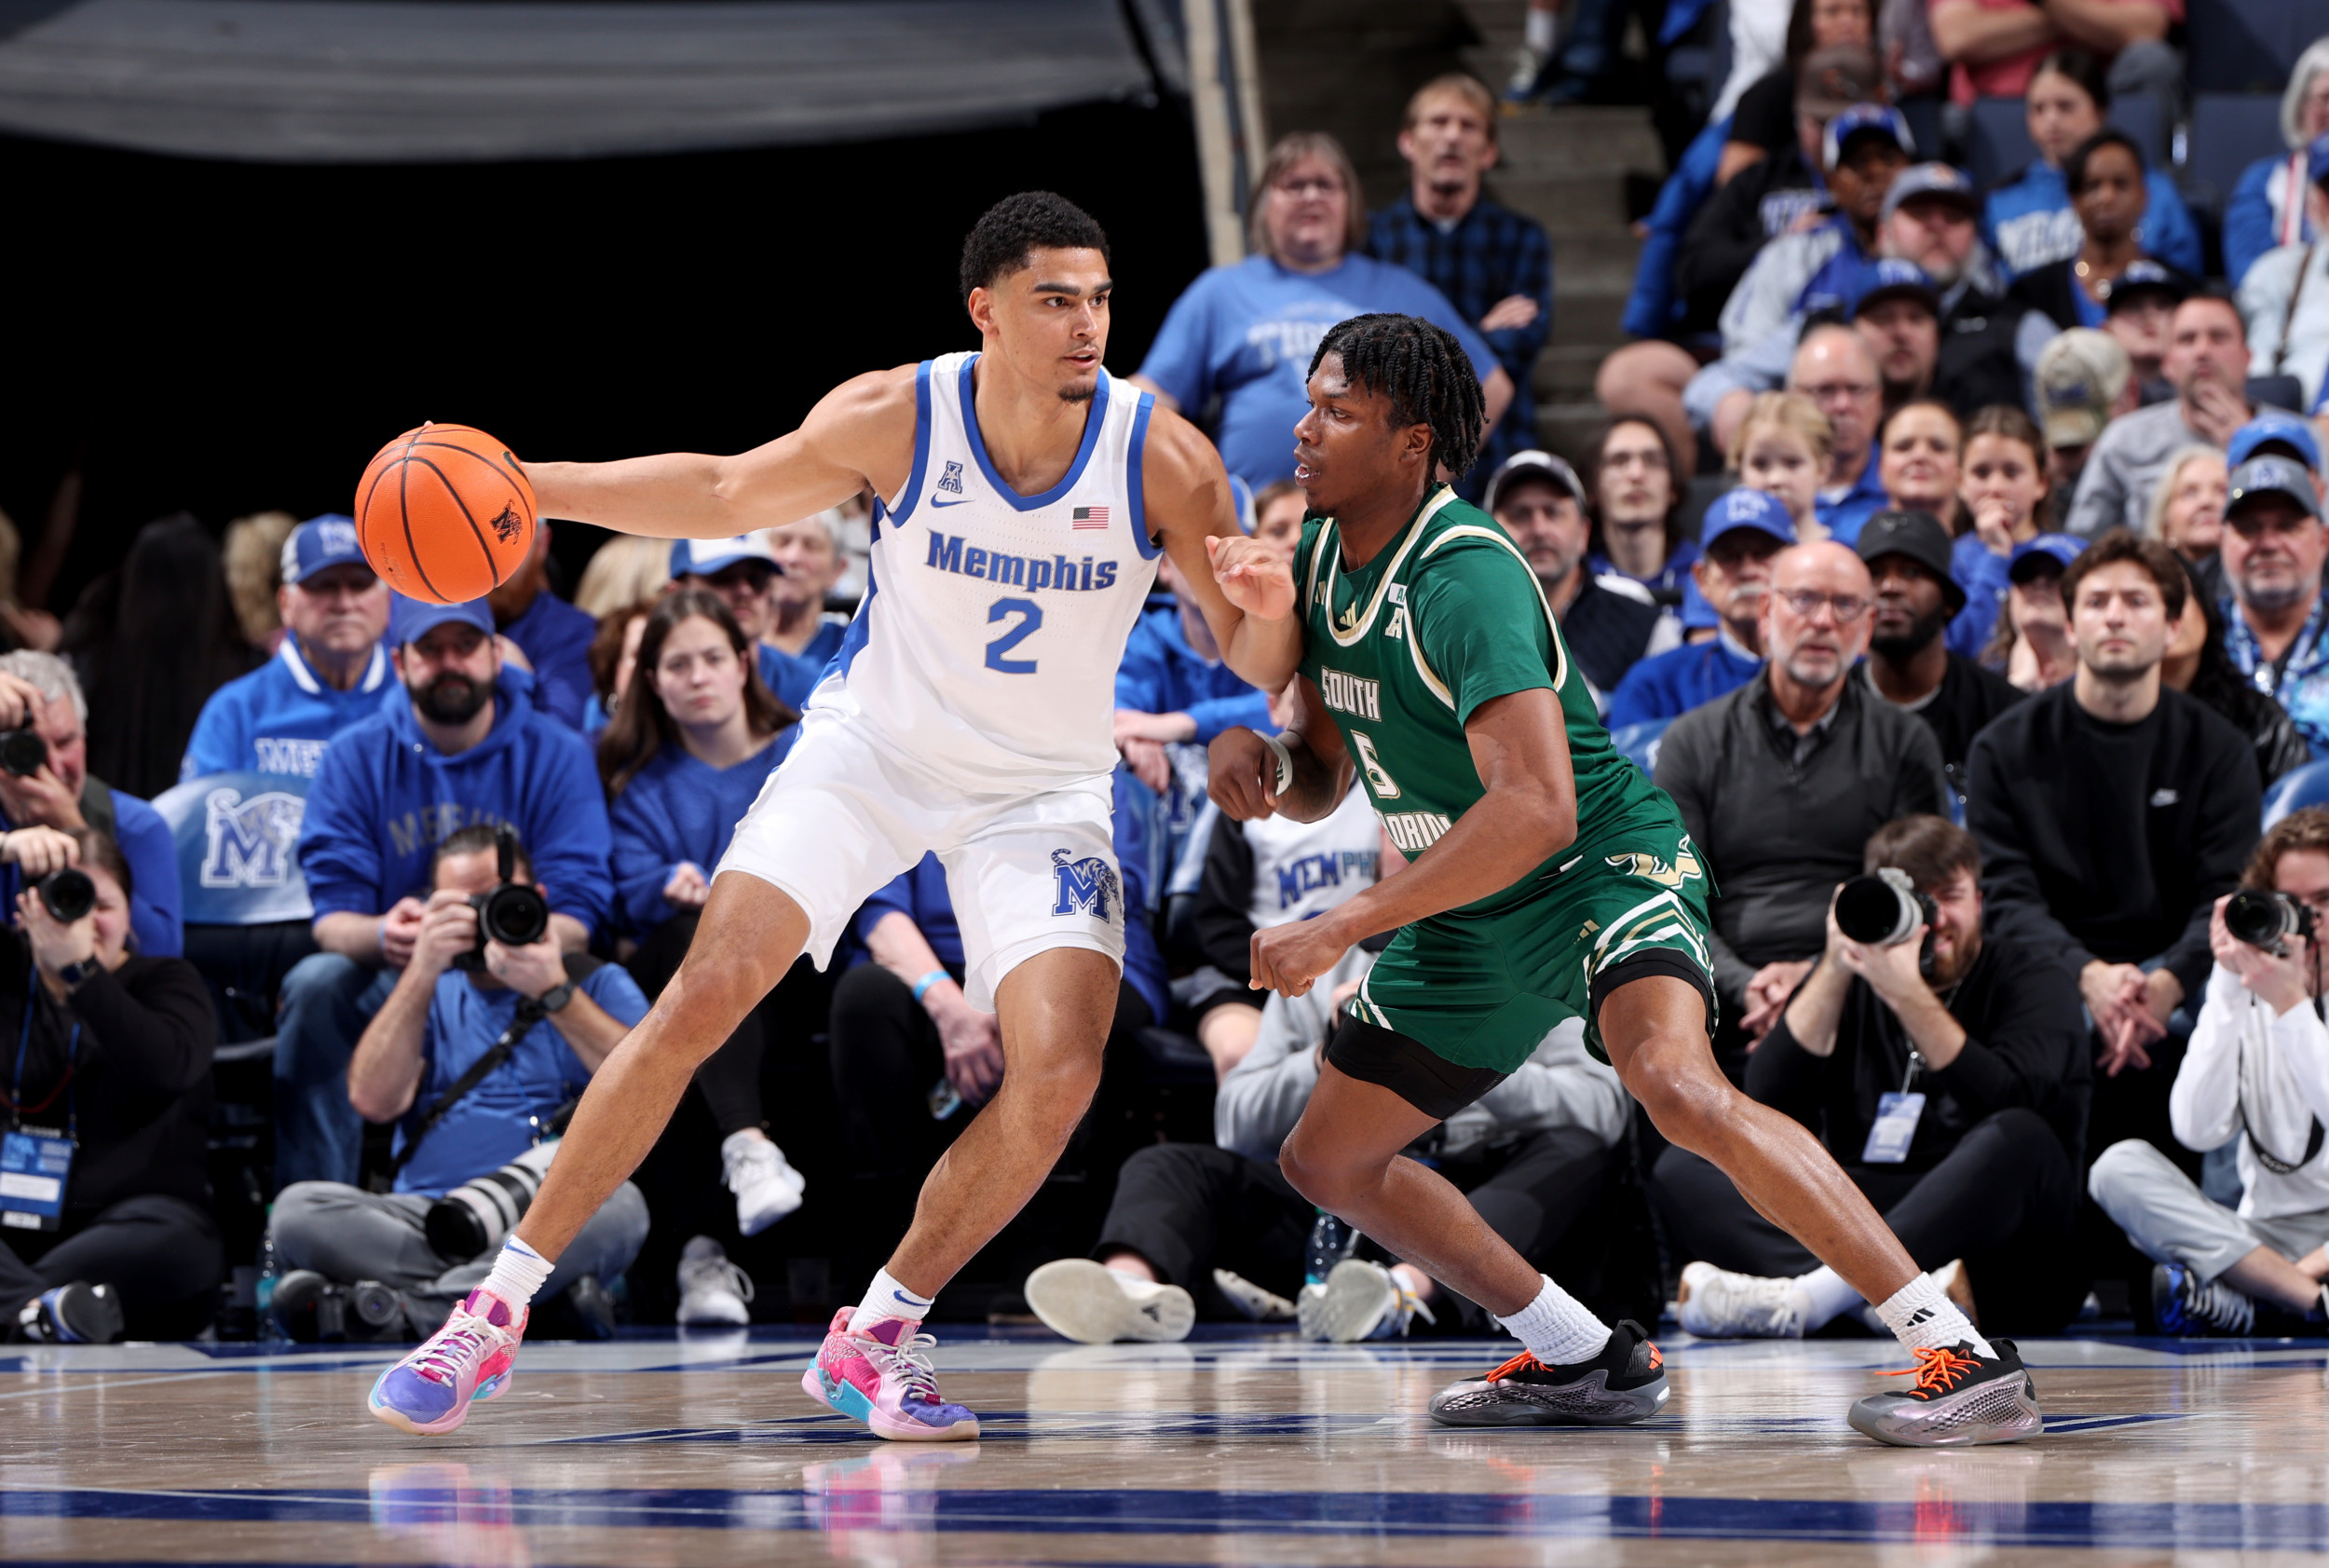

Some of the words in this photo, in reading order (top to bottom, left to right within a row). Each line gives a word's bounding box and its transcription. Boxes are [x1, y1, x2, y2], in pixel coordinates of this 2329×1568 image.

[937, 460, 963, 494] A
[924, 527, 1118, 593] Memphis
[984, 596, 1043, 675] 2
[1383, 606, 1405, 640] A
[1321, 665, 1382, 723] SOUTH
[1350, 728, 1401, 799] 5
[1373, 807, 1454, 852] ORID
[1051, 863, 1110, 924] M
